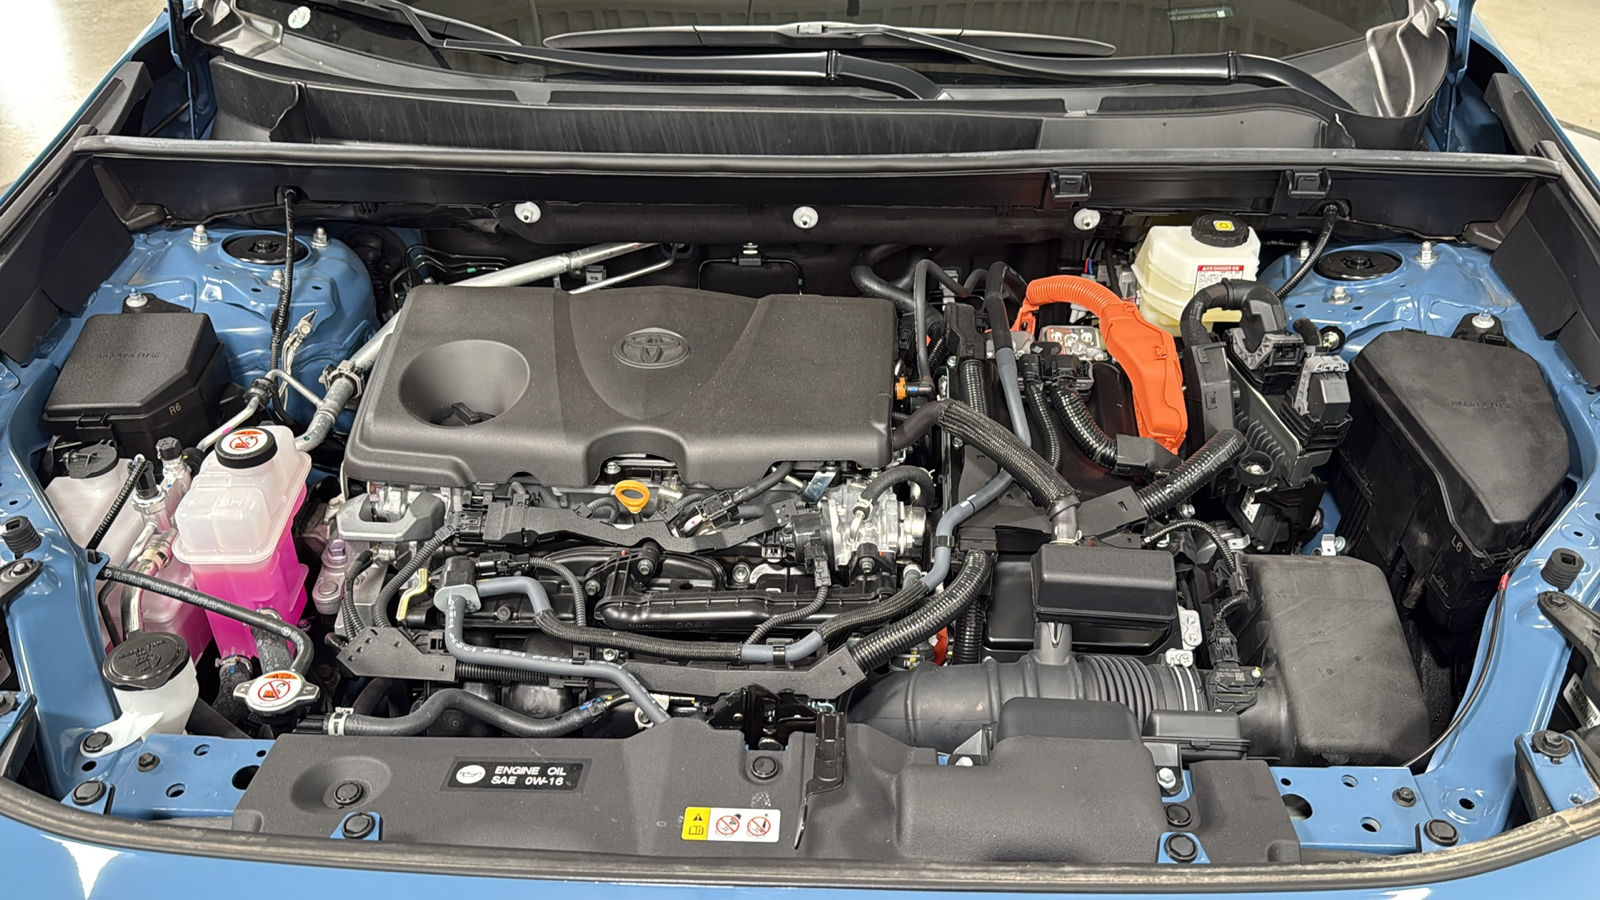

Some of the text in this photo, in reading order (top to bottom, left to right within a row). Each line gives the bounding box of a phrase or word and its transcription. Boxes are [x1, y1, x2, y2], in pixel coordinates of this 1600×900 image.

[168, 402, 182, 415] R6
[1451, 534, 1463, 552] L6
[494, 765, 567, 776] ENGINE OIL
[490, 775, 565, 786] SAE 0W-16
